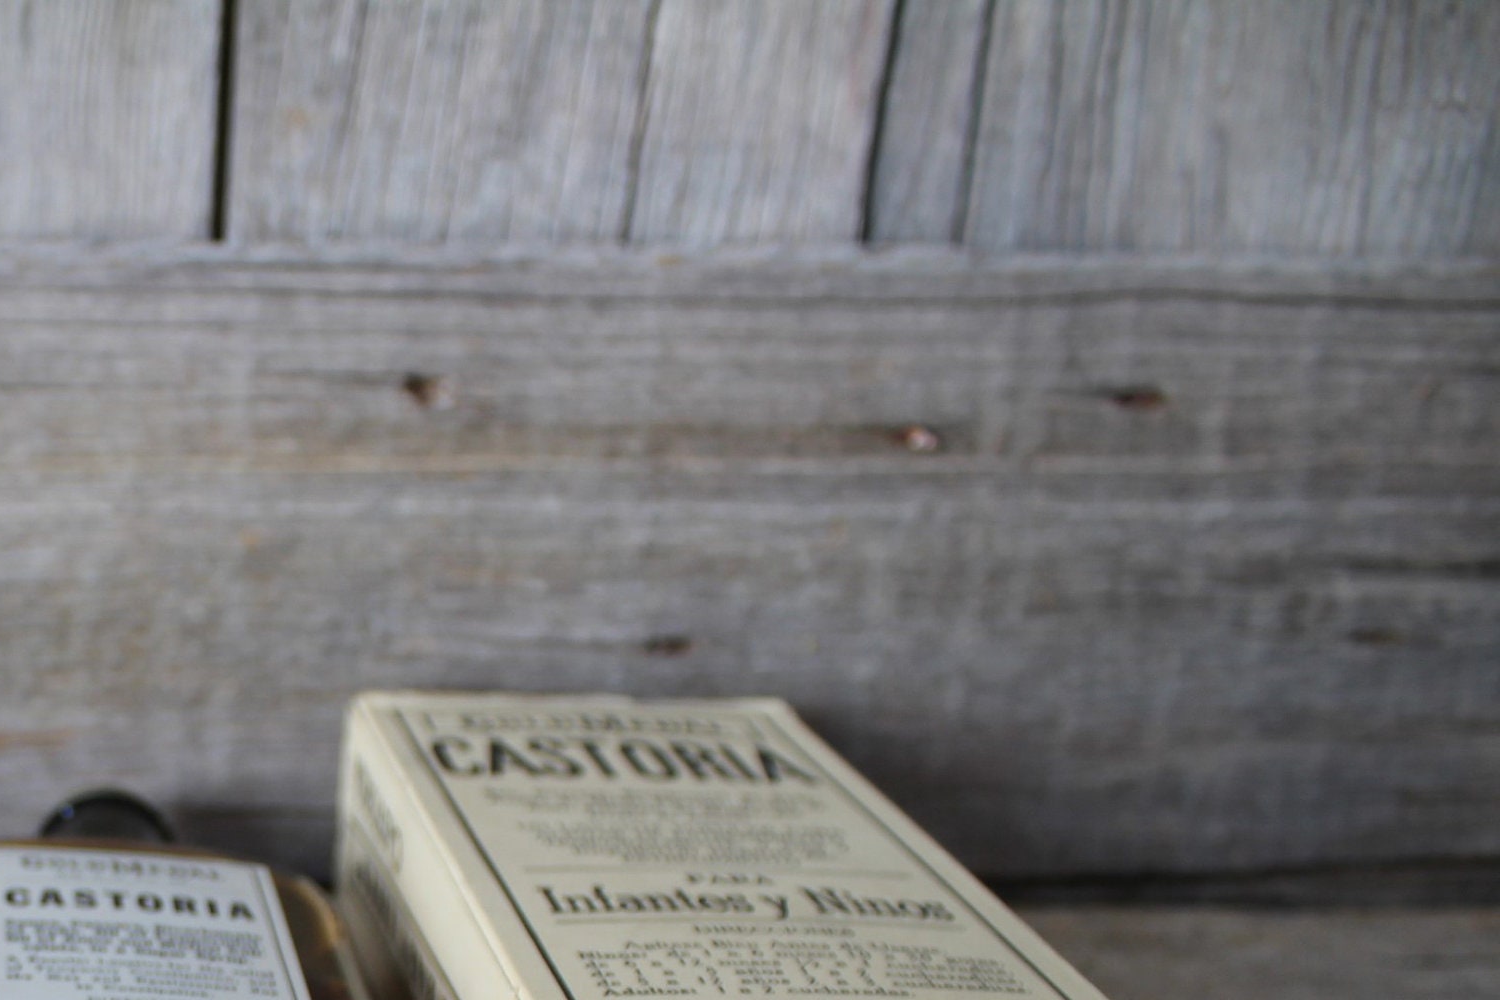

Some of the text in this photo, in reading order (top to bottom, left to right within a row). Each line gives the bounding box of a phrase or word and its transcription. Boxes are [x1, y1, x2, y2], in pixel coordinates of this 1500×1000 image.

[431, 734, 817, 785] CASTORIA
[4, 887, 256, 921] CASTORIA
[539, 886, 955, 922] Infantes y Ninos
